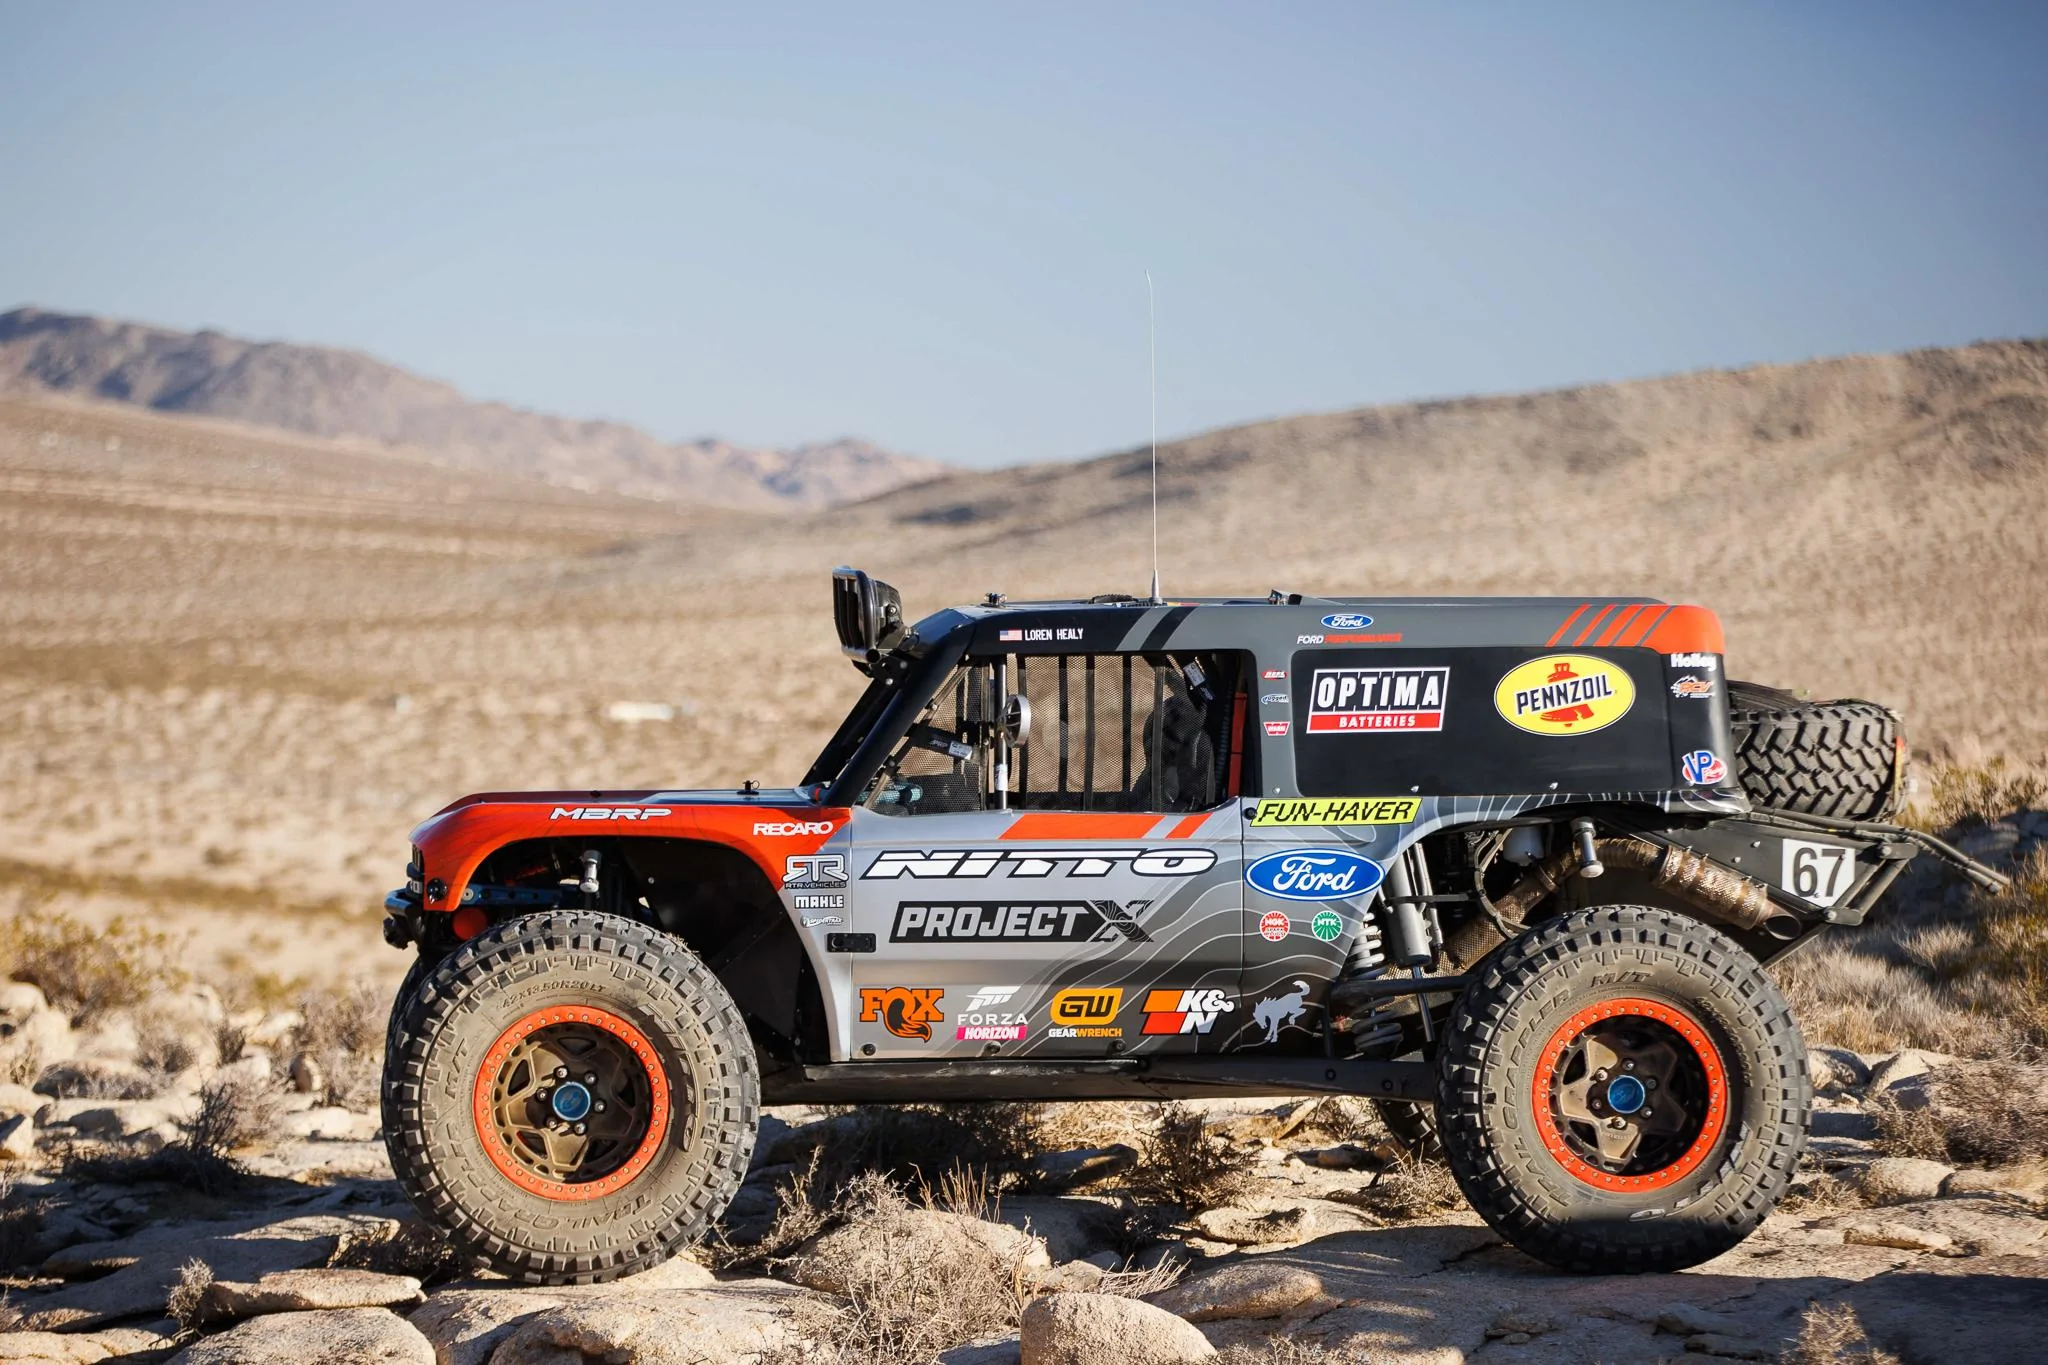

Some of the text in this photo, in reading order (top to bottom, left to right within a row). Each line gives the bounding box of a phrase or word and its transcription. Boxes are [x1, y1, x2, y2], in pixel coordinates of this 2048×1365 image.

[1331, 615, 1363, 627] Ford
[1025, 628, 1084, 640] LOREN HEALY
[1296, 635, 1324, 644] FORD
[1670, 653, 1717, 671] Holley
[1317, 676, 1439, 708] OPTIMA
[1516, 675, 1612, 715] PENNZOIL
[1339, 715, 1416, 728] BATTERIES
[1682, 750, 1713, 783] VP
[549, 807, 672, 820] MBRP
[1258, 801, 1413, 823] FUN-HAVER
[753, 821, 834, 836] RECARO
[859, 848, 1218, 880] NITTO
[1273, 856, 1358, 891] Ford
[1793, 847, 1845, 897] 67
[795, 895, 844, 908] MAHLE
[896, 900, 1154, 943] PROJECT X
[1265, 918, 1285, 926] NGK
[1317, 918, 1337, 926] NTK
[860, 987, 945, 1041] FOX
[957, 1013, 1028, 1025] FORZA
[964, 1026, 1020, 1040] HORIZON
[1049, 1028, 1122, 1038] GEARWRENCH
